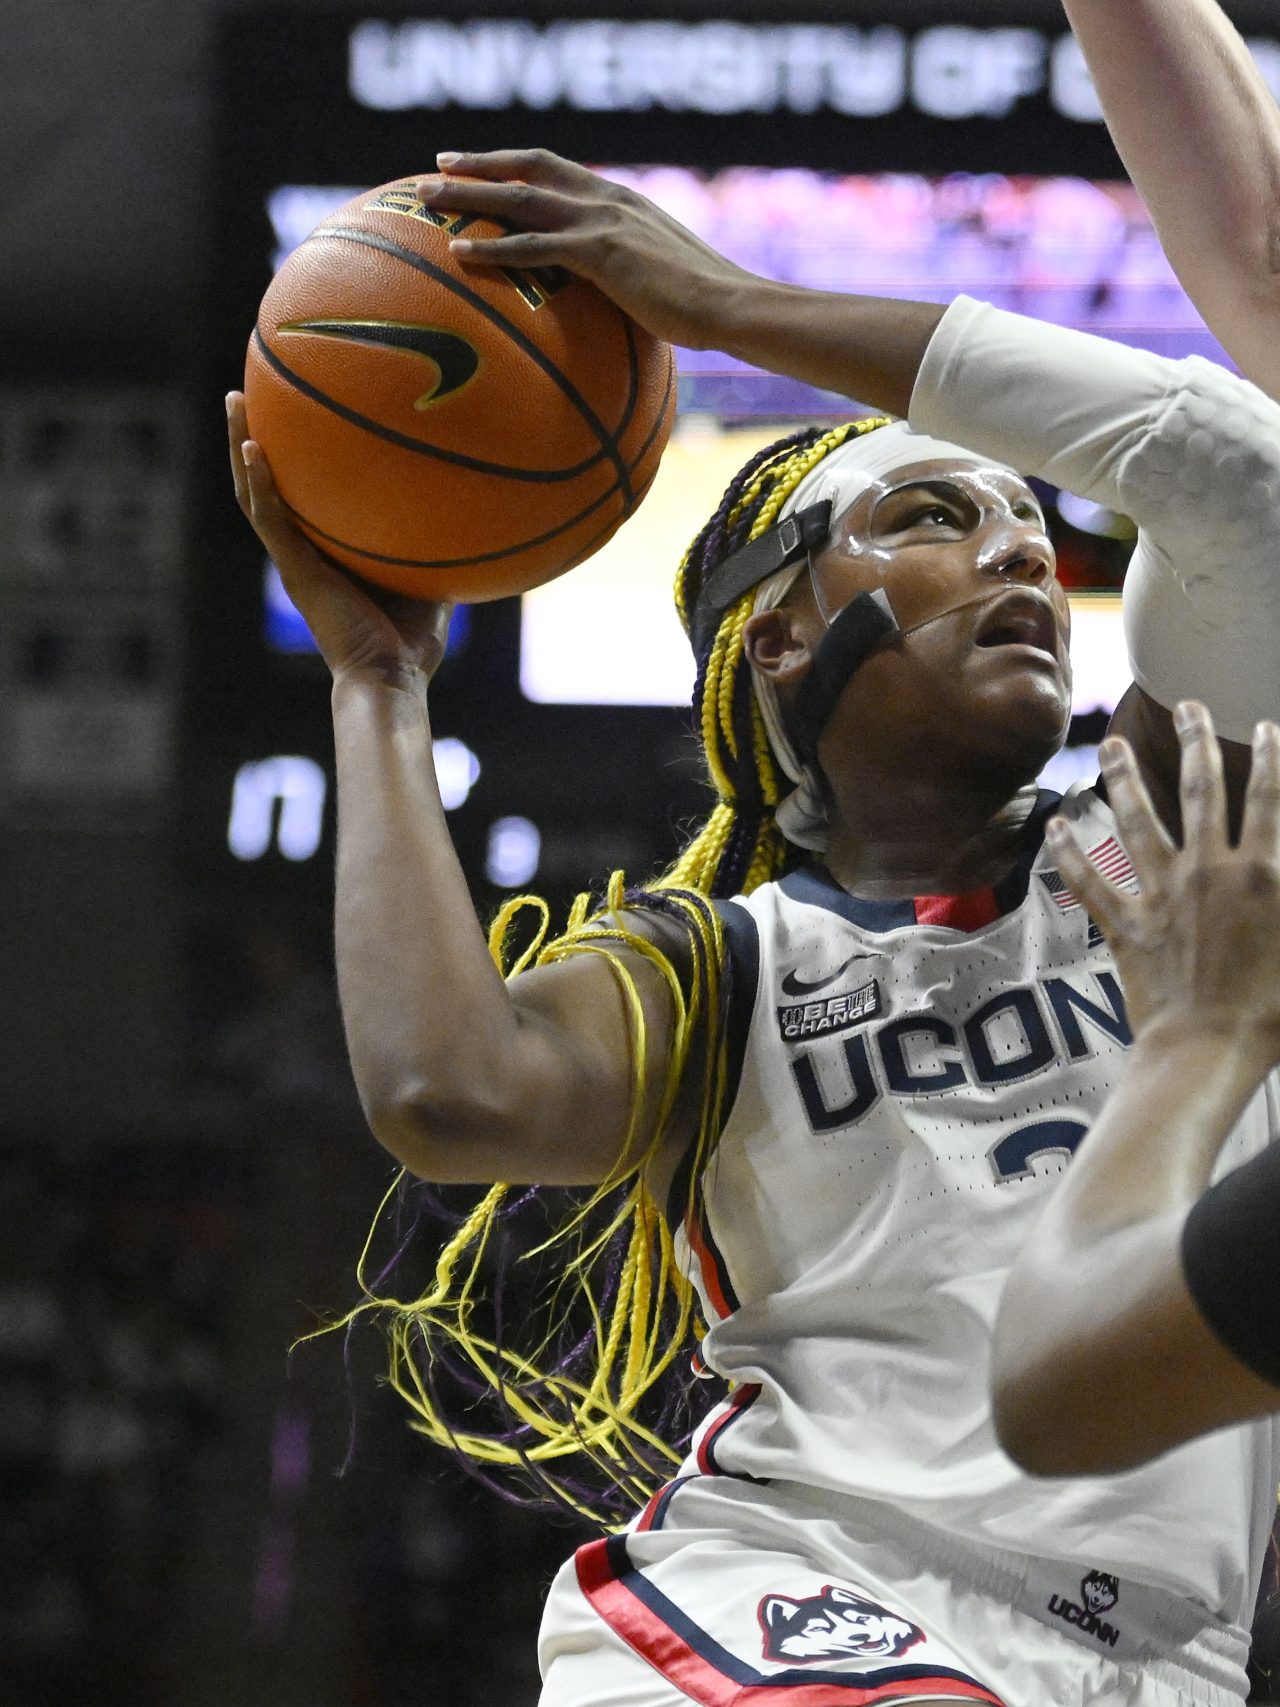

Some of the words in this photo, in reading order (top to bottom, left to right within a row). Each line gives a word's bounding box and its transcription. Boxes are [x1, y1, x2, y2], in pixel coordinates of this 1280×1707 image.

[350, 22, 901, 114] UNIVERSITY
[910, 27, 1043, 118] OF
[784, 999, 877, 1037] CHANGE
[790, 970, 1135, 1135] UCON
[1047, 1594, 1120, 1648] UCONN
